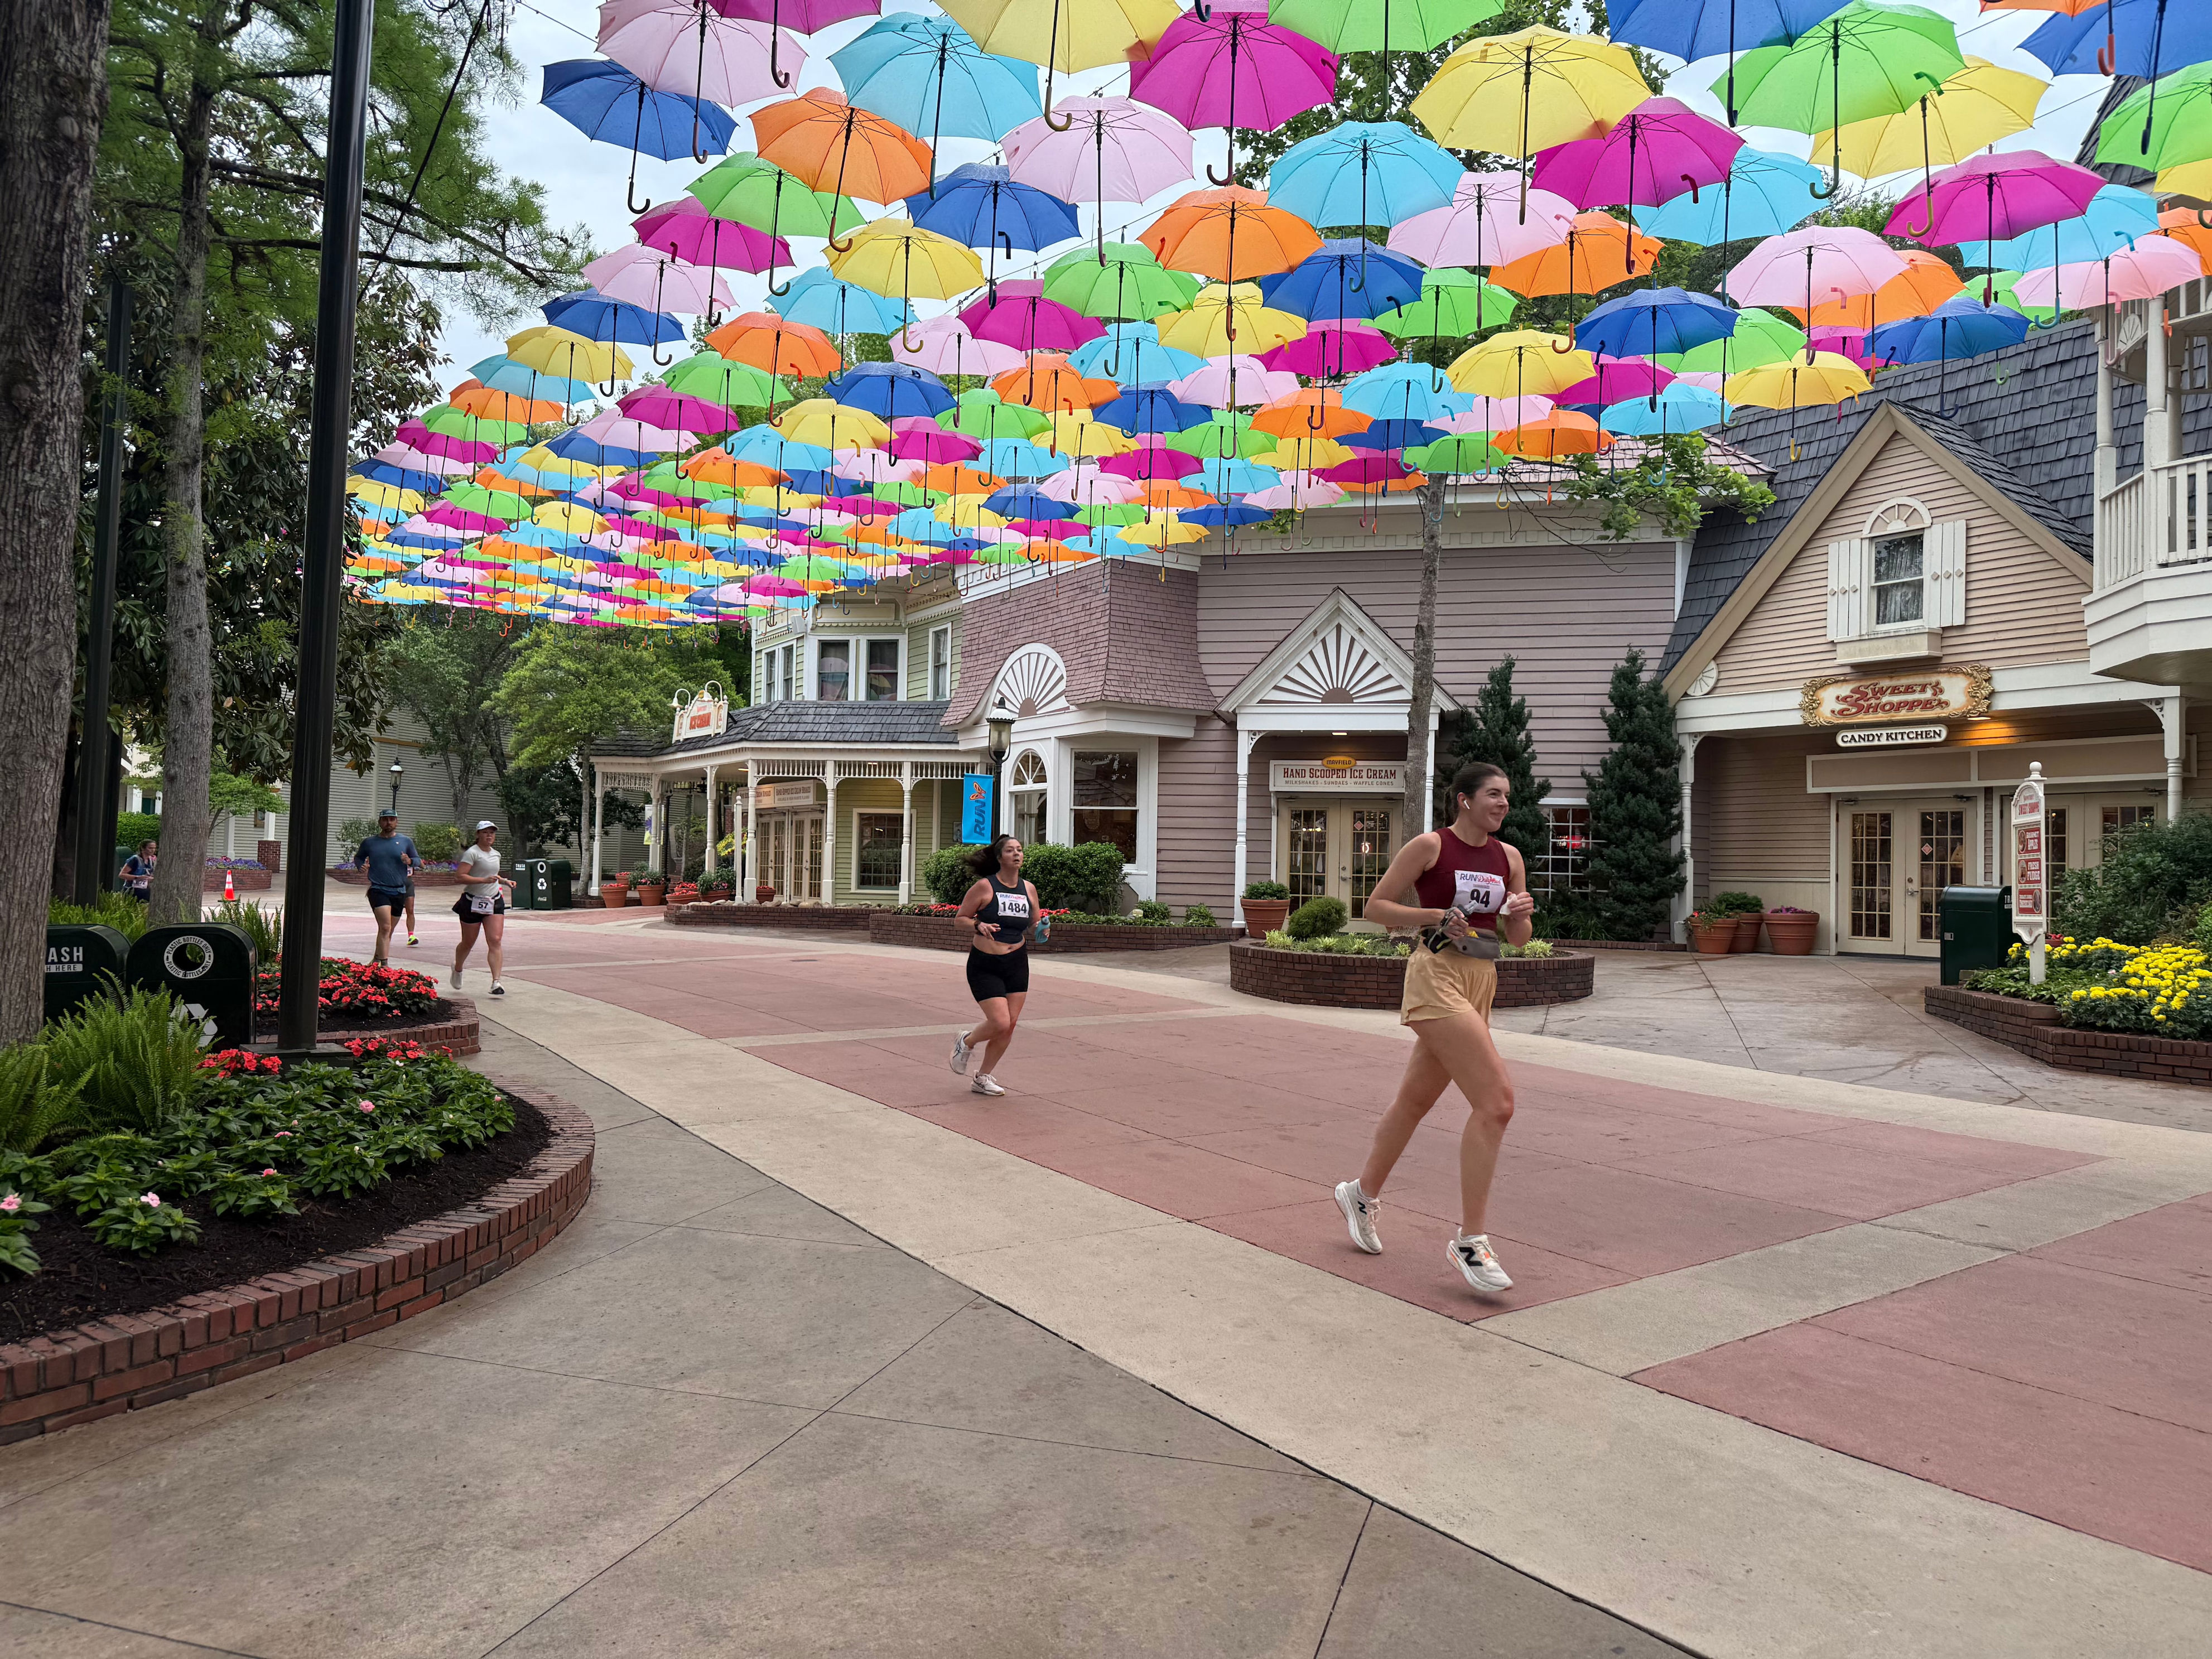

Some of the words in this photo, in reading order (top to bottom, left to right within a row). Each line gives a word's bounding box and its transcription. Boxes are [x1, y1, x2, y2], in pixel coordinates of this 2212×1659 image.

[1836, 680, 1944, 702] SWEET
[1831, 697, 1949, 717] SHOPPE
[1841, 733, 1883, 743] CANDY
[1886, 730, 1941, 741] KITCHEN
[1283, 768, 1306, 778] HAND
[1309, 768, 1347, 779] SCOOPED
[1350, 768, 1363, 779] ICE
[1367, 768, 1396, 779] CREAM
[974, 799, 986, 837] RUN
[1460, 873, 1477, 882] RUN
[1469, 889, 1490, 908] 94
[1001, 901, 1027, 914] 1484
[166, 939, 182, 954] PLASTIC
[183, 937, 203, 945] BOTTLES
[203, 943, 211, 953] ONLY
[47, 946, 83, 962] ASH
[166, 961, 181, 976] PLASTIC
